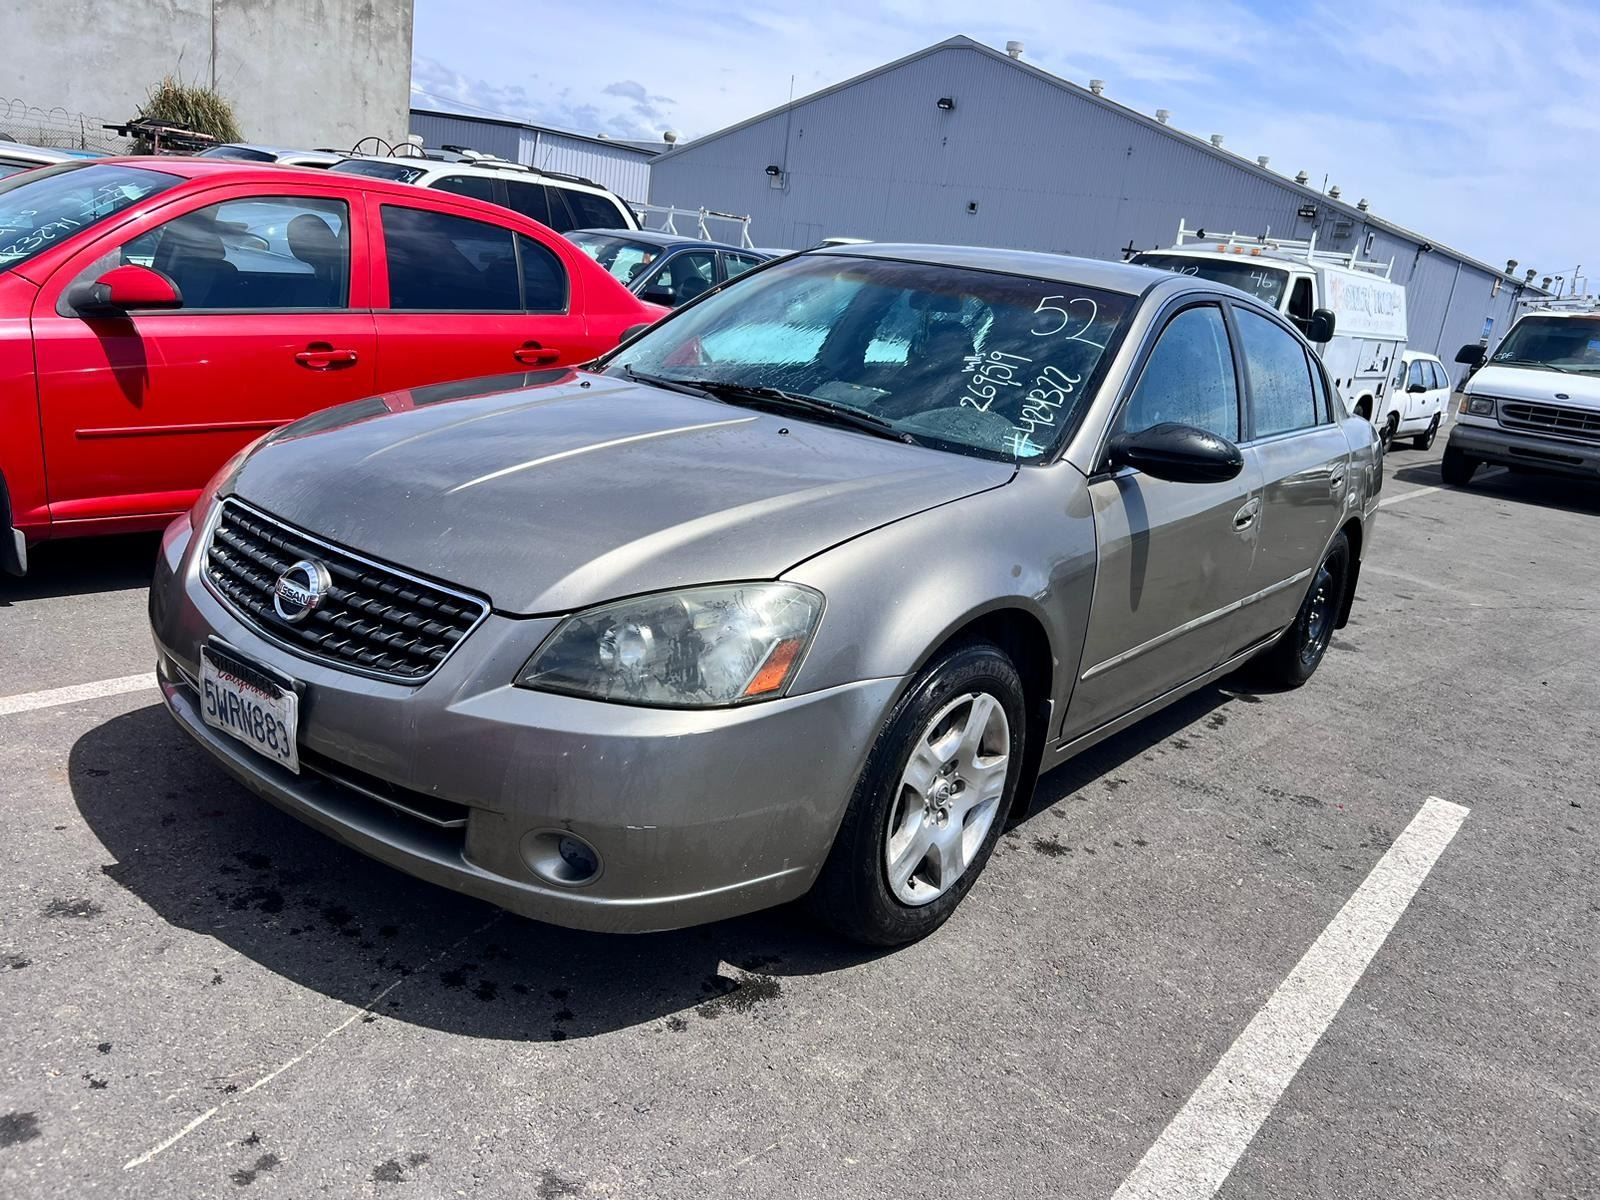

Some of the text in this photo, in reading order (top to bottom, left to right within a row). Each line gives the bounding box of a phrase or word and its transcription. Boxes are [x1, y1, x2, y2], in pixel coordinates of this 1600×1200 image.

[0, 217, 80, 254] 23271
[1250, 271, 1272, 288] 46
[1030, 296, 1105, 349] 52
[1003, 366, 1081, 456] #424322
[276, 580, 312, 604] NISSAN
[204, 677, 290, 758] 5WRN883
